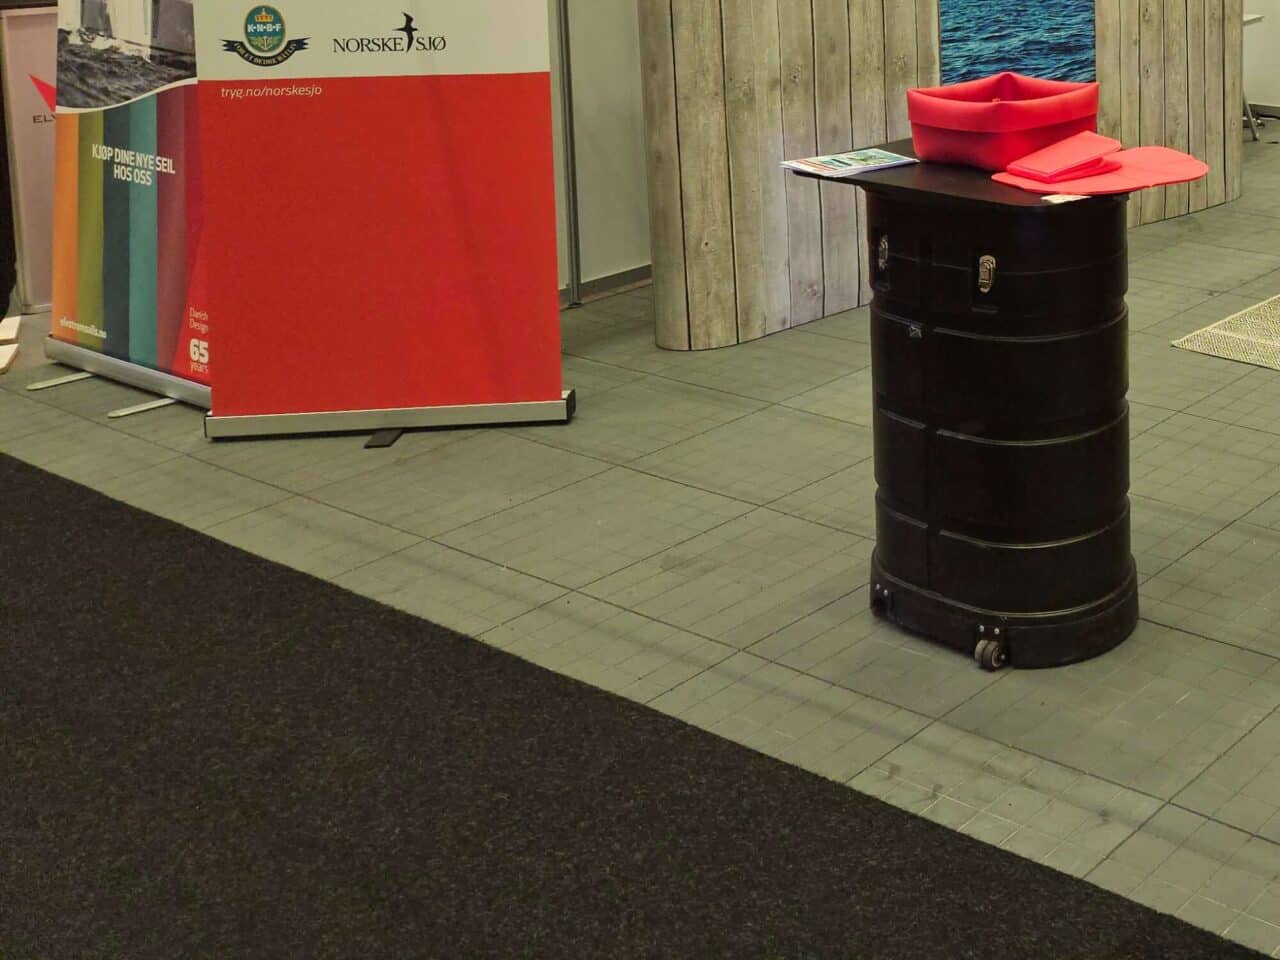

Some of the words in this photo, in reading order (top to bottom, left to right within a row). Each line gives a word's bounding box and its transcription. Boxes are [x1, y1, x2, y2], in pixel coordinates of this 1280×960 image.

[333, 36, 404, 53] NORSKE
[415, 36, 447, 52] SJØ
[92, 144, 113, 161] KJØP
[114, 148, 135, 166] DINE
[136, 152, 154, 170] NYE
[155, 156, 176, 174] SEIL
[113, 164, 132, 181] HOS
[134, 170, 152, 185] OSS
[189, 338, 209, 364] 65
